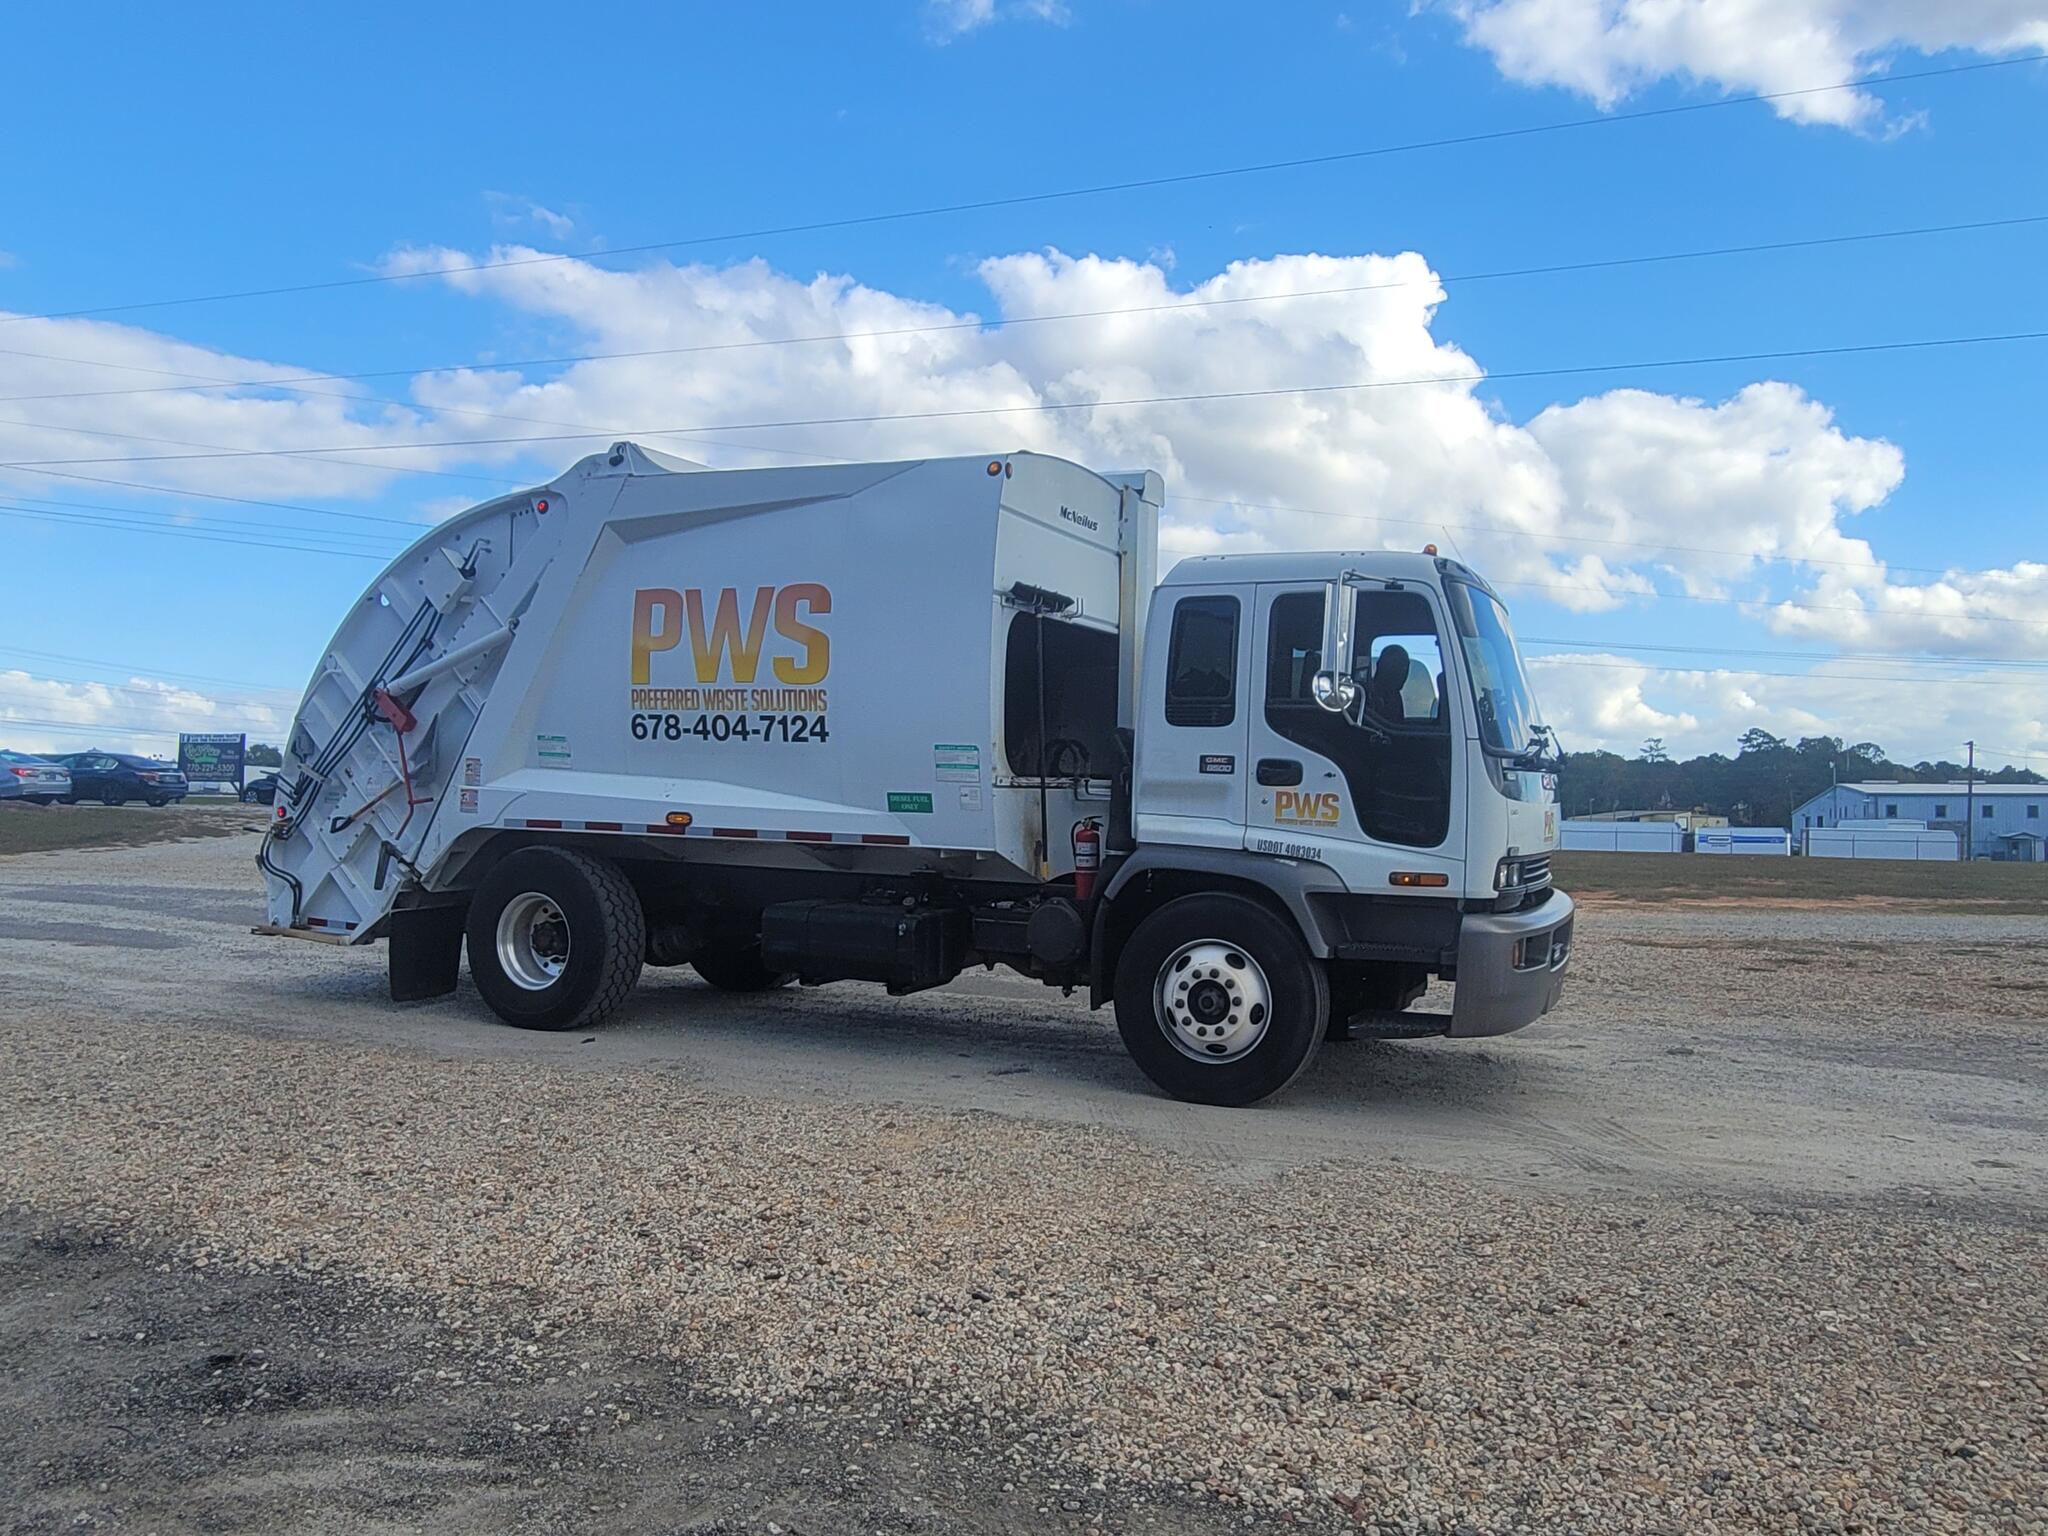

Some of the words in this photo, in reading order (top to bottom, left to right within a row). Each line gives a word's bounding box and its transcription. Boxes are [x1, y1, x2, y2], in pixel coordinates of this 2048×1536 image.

[1060, 505, 1098, 531] McNeilus
[631, 583, 832, 685] PWS
[631, 689, 700, 711] PREFERRED
[703, 689, 748, 711] WASTE
[751, 689, 827, 712] SOLUTIONS
[631, 714, 829, 743] 678-404-7124
[1275, 791, 1340, 820] PWS
[1257, 839, 1284, 853] USDOT
[1285, 843, 1322, 859] 4083034
